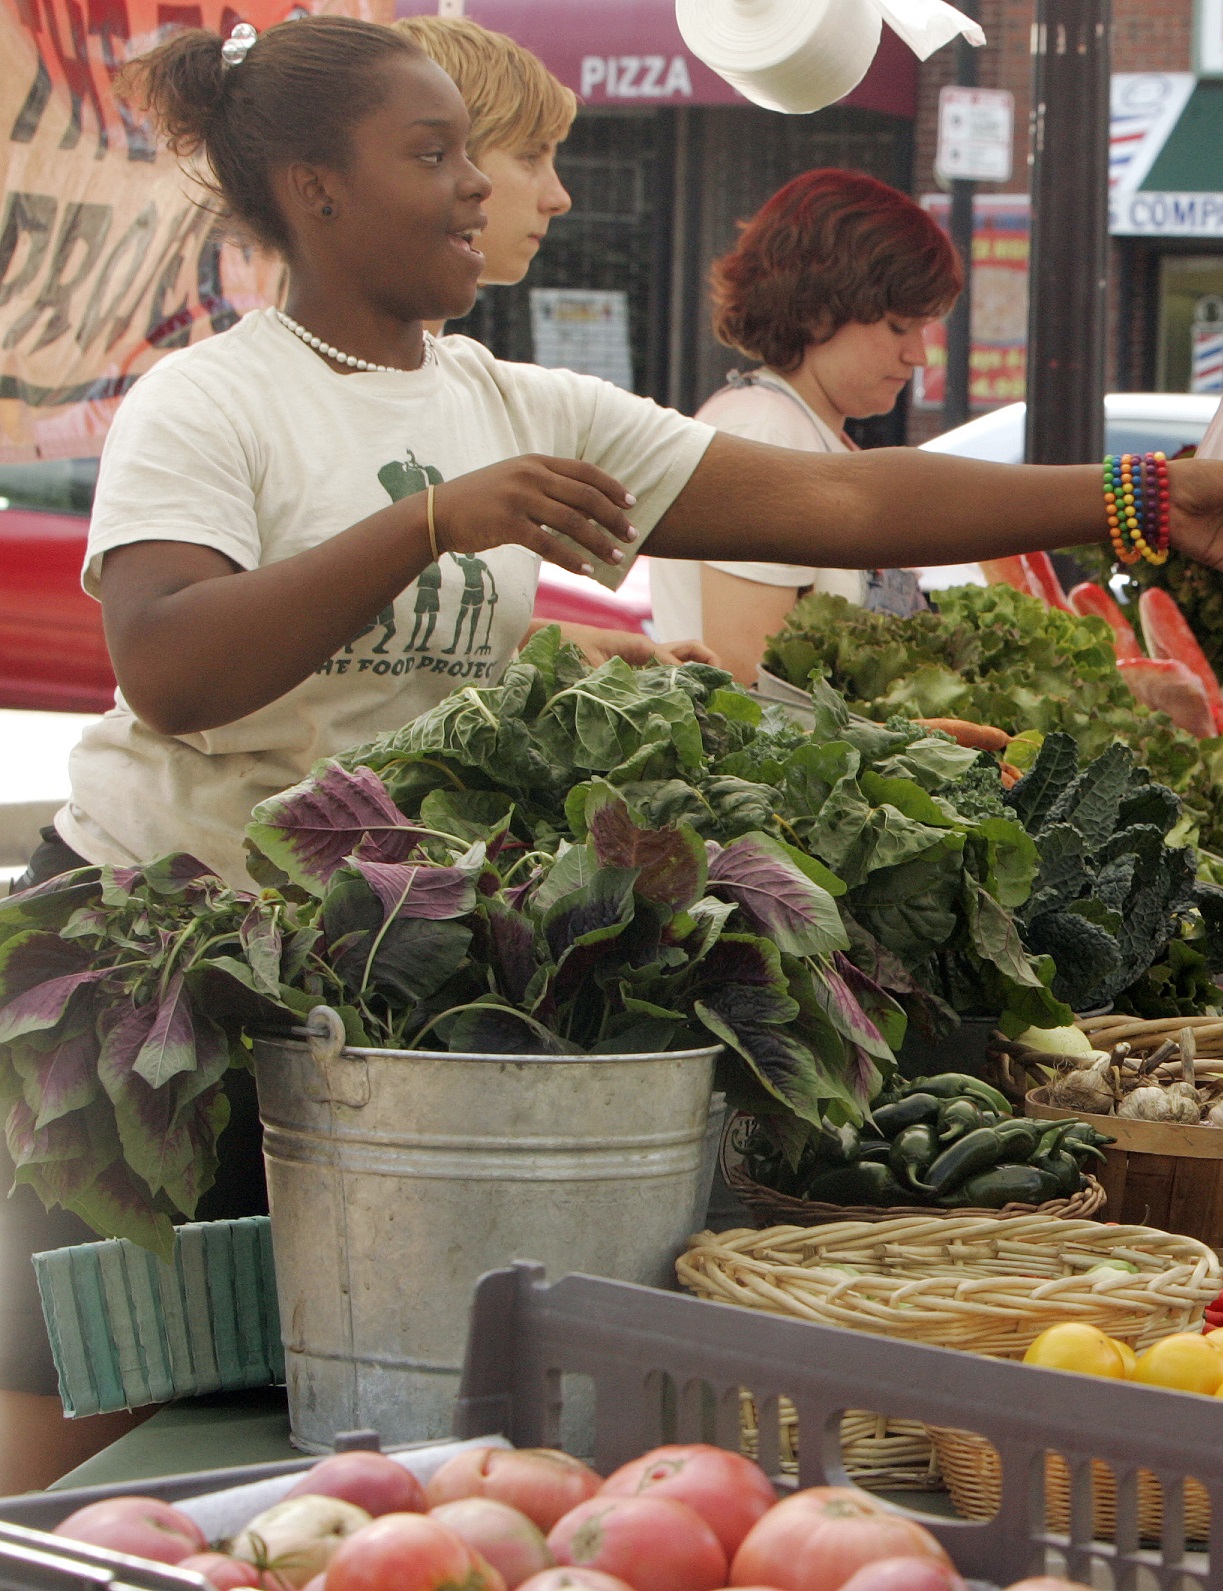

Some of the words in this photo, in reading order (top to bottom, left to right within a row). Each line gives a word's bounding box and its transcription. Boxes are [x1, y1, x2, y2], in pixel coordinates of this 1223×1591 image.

[580, 55, 694, 98] PIZZA
[356, 656, 415, 677] FOOD
[415, 655, 498, 680] PROJEC
